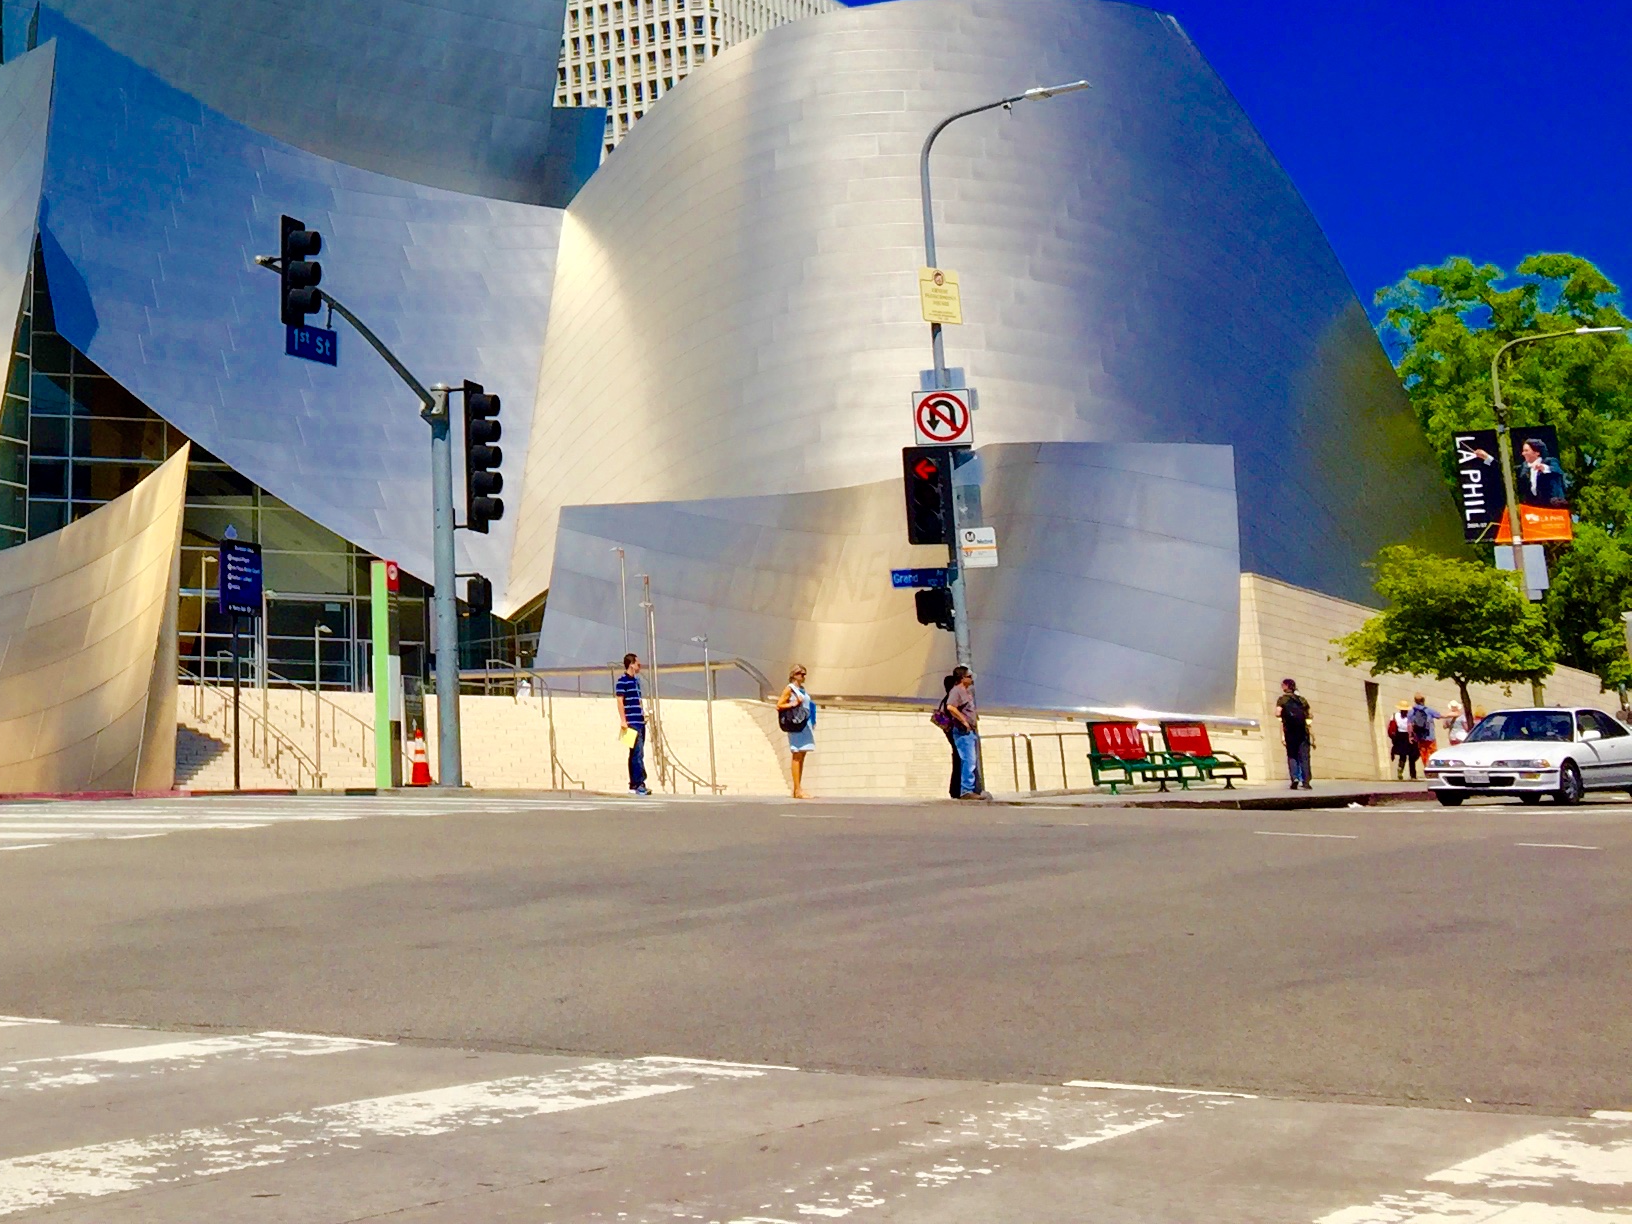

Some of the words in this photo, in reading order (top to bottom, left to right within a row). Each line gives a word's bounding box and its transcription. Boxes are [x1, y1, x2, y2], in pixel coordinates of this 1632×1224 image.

[293, 328, 310, 351] 1st
[315, 336, 331, 357] St
[1455, 436, 1478, 464] LA
[1459, 469, 1486, 522] PHIL
